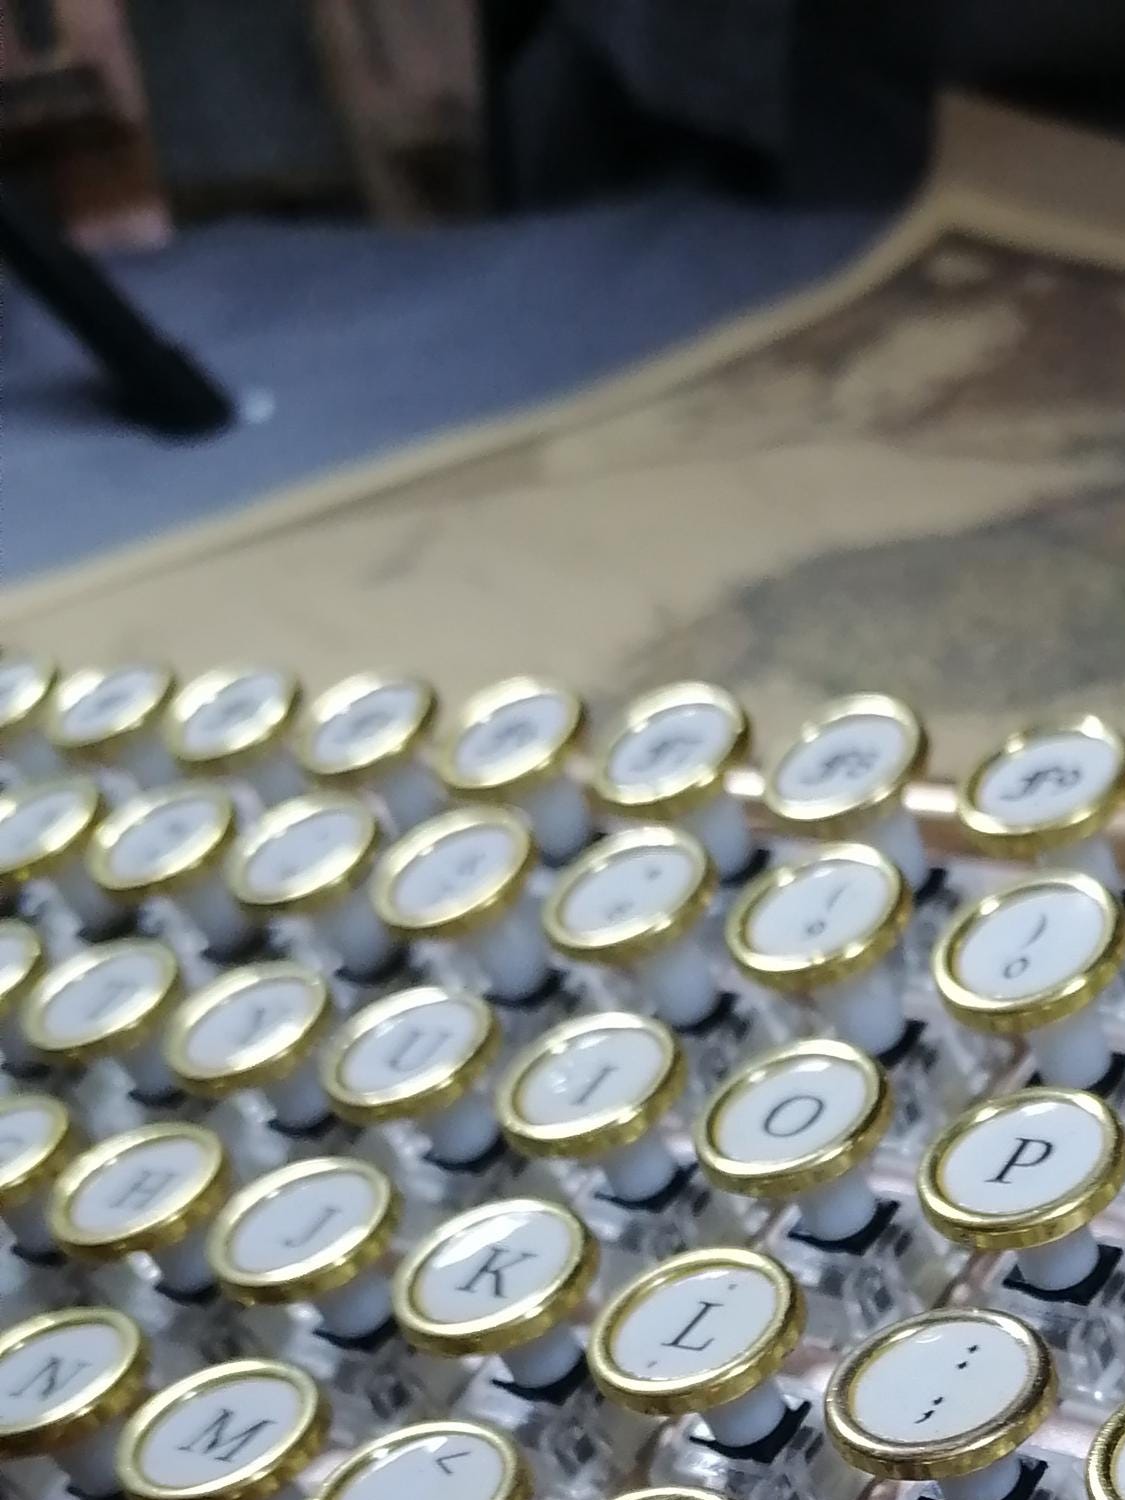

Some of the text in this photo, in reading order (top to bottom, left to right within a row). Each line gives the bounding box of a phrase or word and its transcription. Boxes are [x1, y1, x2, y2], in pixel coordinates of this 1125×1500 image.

[984, 1136, 1054, 1185] P
[108, 1168, 178, 1210] H
[283, 1205, 343, 1249] J
[455, 1245, 540, 1299] K
[661, 1300, 724, 1353] L
[9, 1355, 92, 1401] N
[177, 1407, 279, 1463] M
